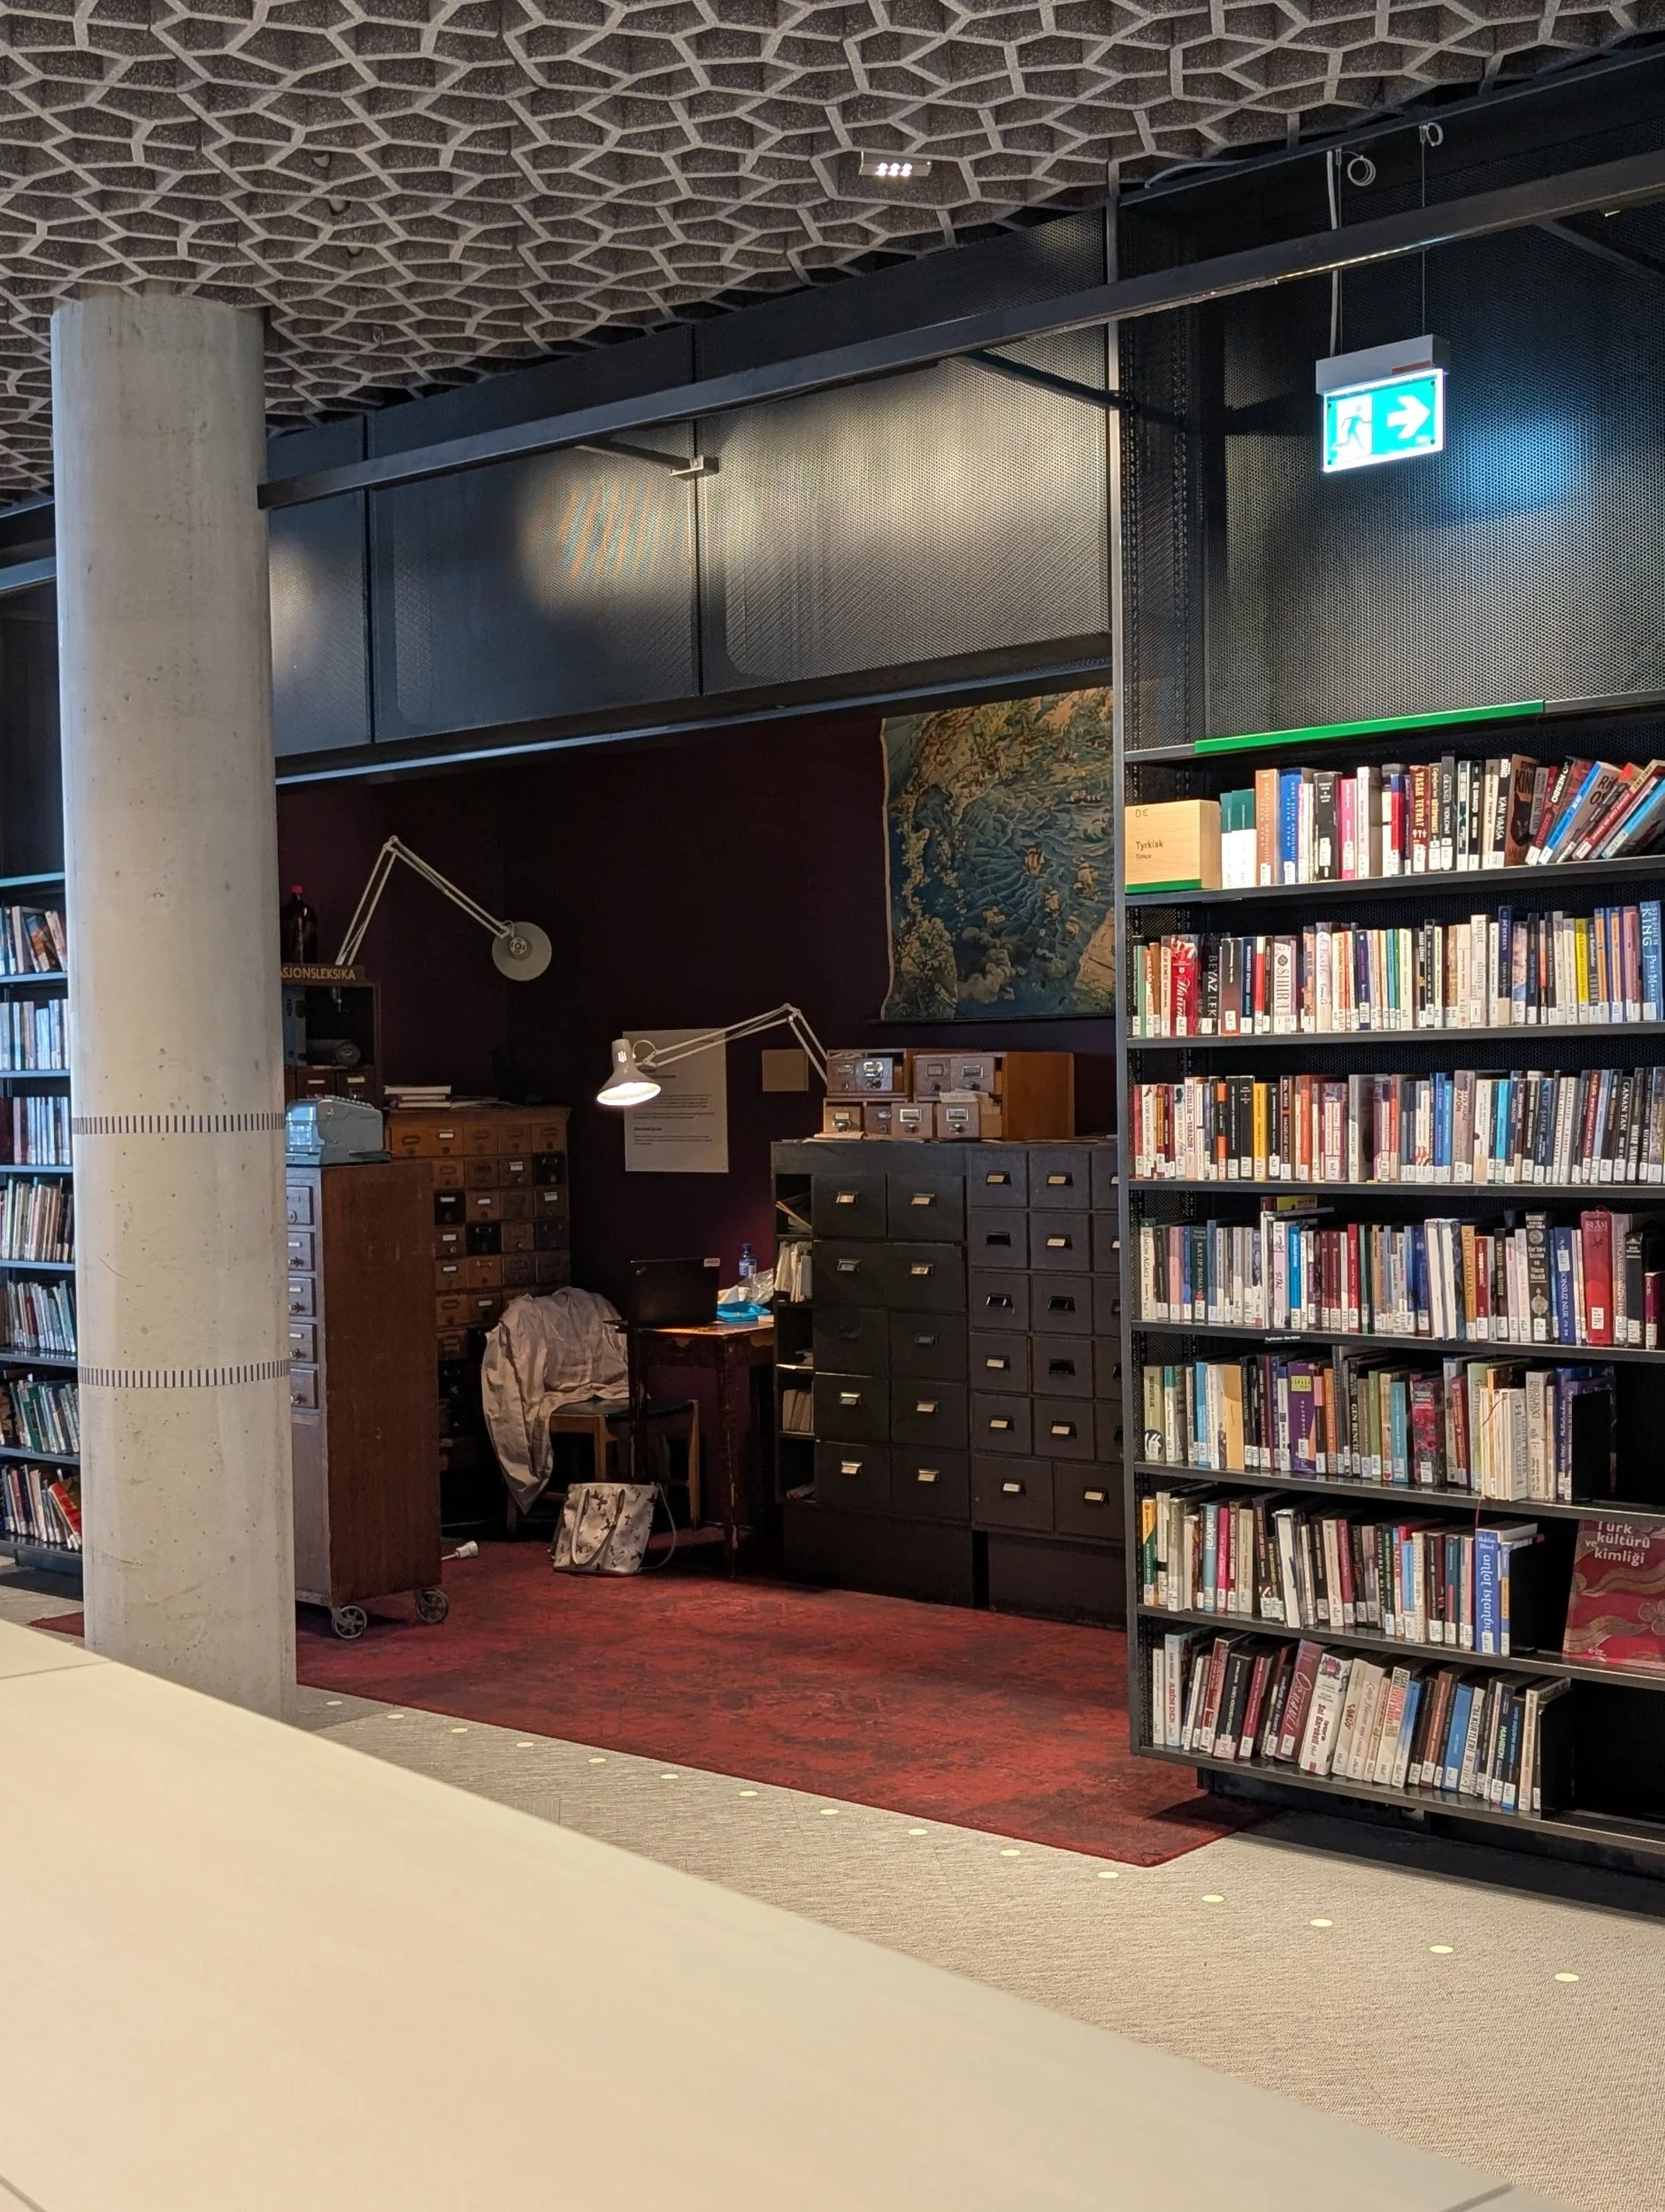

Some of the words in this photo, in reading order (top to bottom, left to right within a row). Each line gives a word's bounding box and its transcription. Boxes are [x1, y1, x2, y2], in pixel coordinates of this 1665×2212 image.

[1415, 772, 1423, 796] YASAK
[1136, 809, 1148, 818] DE
[1136, 840, 1163, 851] Tyrkisk
[1642, 908, 1652, 946] KING
[1208, 956, 1217, 992] BEYAZ
[1477, 962, 1485, 990] dünya
[1647, 974, 1656, 1002] MASAL
[1621, 1082, 1630, 1112] CANAN
[1597, 1532, 1650, 1548] kültürü
[1480, 1555, 1492, 1586] anlat
[1594, 1548, 1645, 1566] kimliği
[1480, 1589, 1493, 1632] istanbu
[1497, 1726, 1507, 1759] MAHREM
